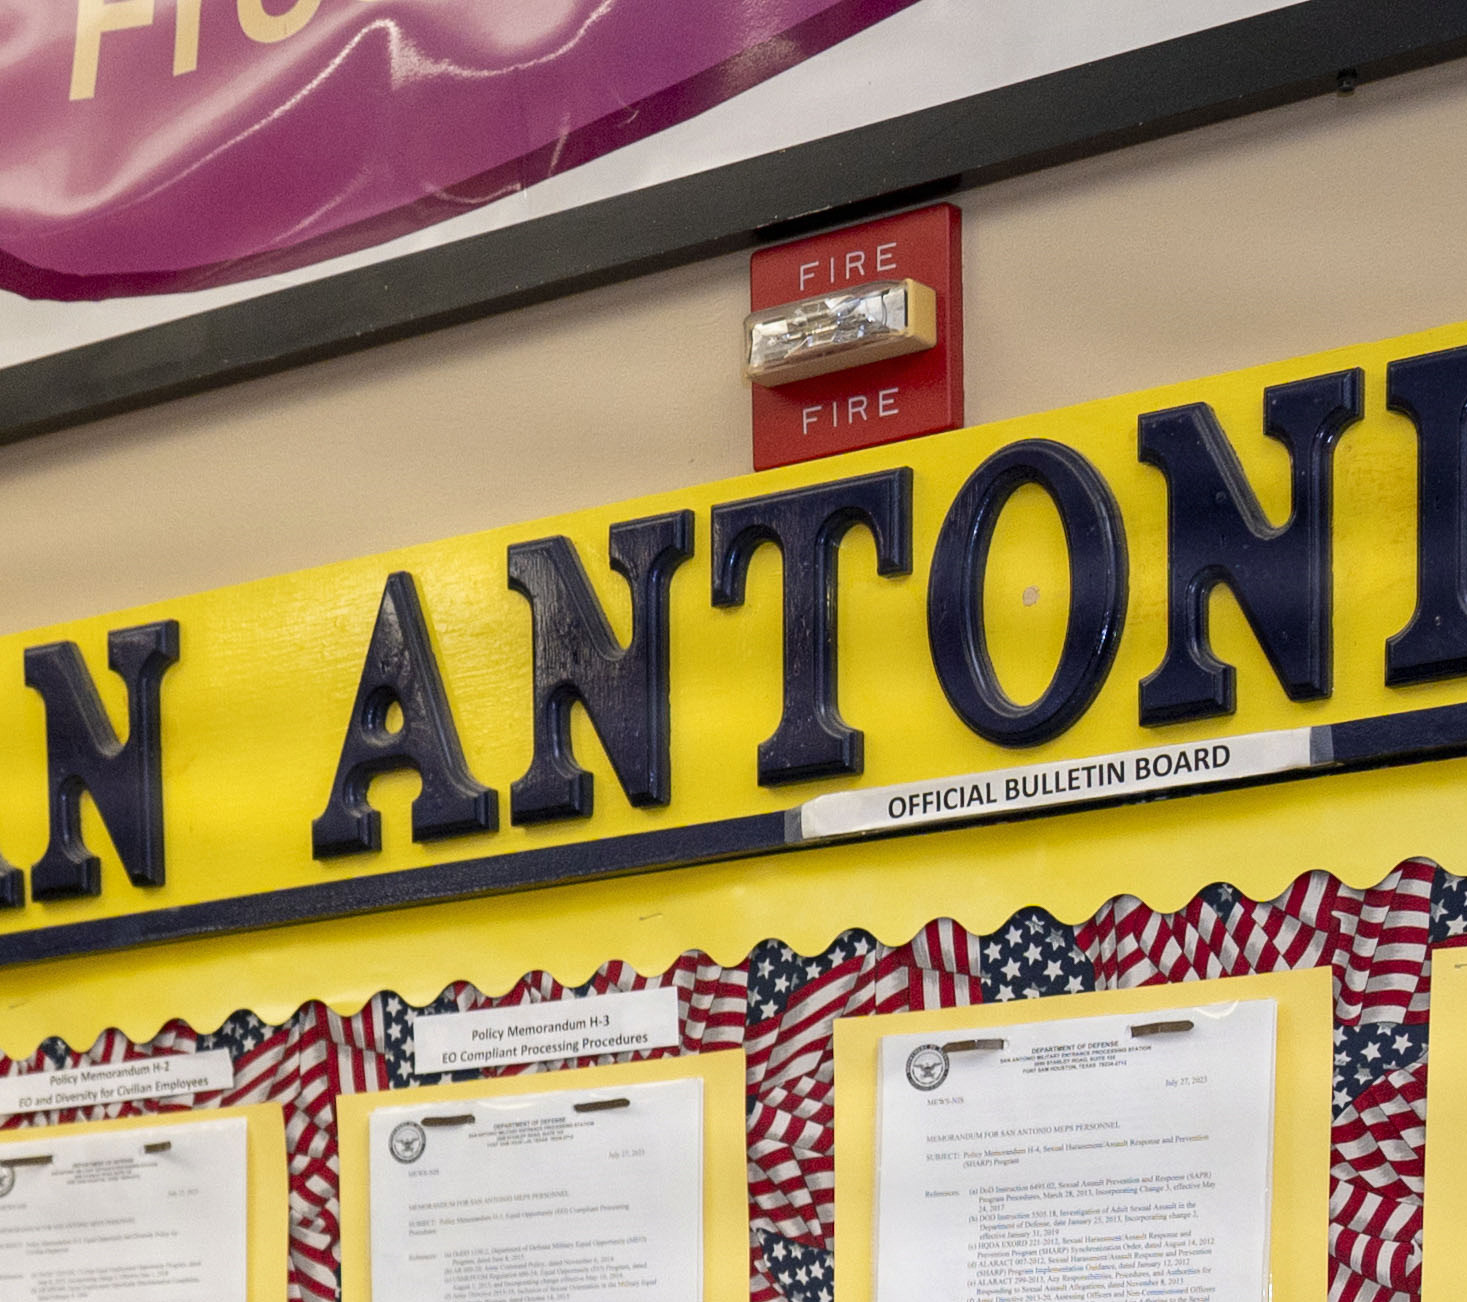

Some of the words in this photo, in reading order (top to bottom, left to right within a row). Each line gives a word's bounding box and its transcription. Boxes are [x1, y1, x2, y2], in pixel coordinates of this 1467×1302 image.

[798, 242, 901, 292] FIRE
[801, 389, 902, 438] FIRE
[887, 782, 997, 819] OFFICIAL
[1004, 761, 1125, 807] BULLETIN
[1135, 744, 1231, 780] BOARD
[471, 1028, 505, 1042] Policy
[507, 1018, 587, 1038] Memorandum
[589, 1014, 610, 1027] H-3
[441, 1051, 458, 1064] EO
[460, 1045, 518, 1064] Compliant
[520, 1039, 579, 1058] Processing
[581, 1031, 649, 1049] Procedures
[35, 1094, 52, 1106] and
[55, 1089, 98, 1105] Diversity
[100, 1087, 114, 1098] for
[117, 1083, 152, 1097] Civilian
[155, 1076, 209, 1093] Employees
[50, 1073, 78, 1087] Policy
[81, 1065, 150, 1082] Memorandum
[153, 1062, 170, 1074] H-2
